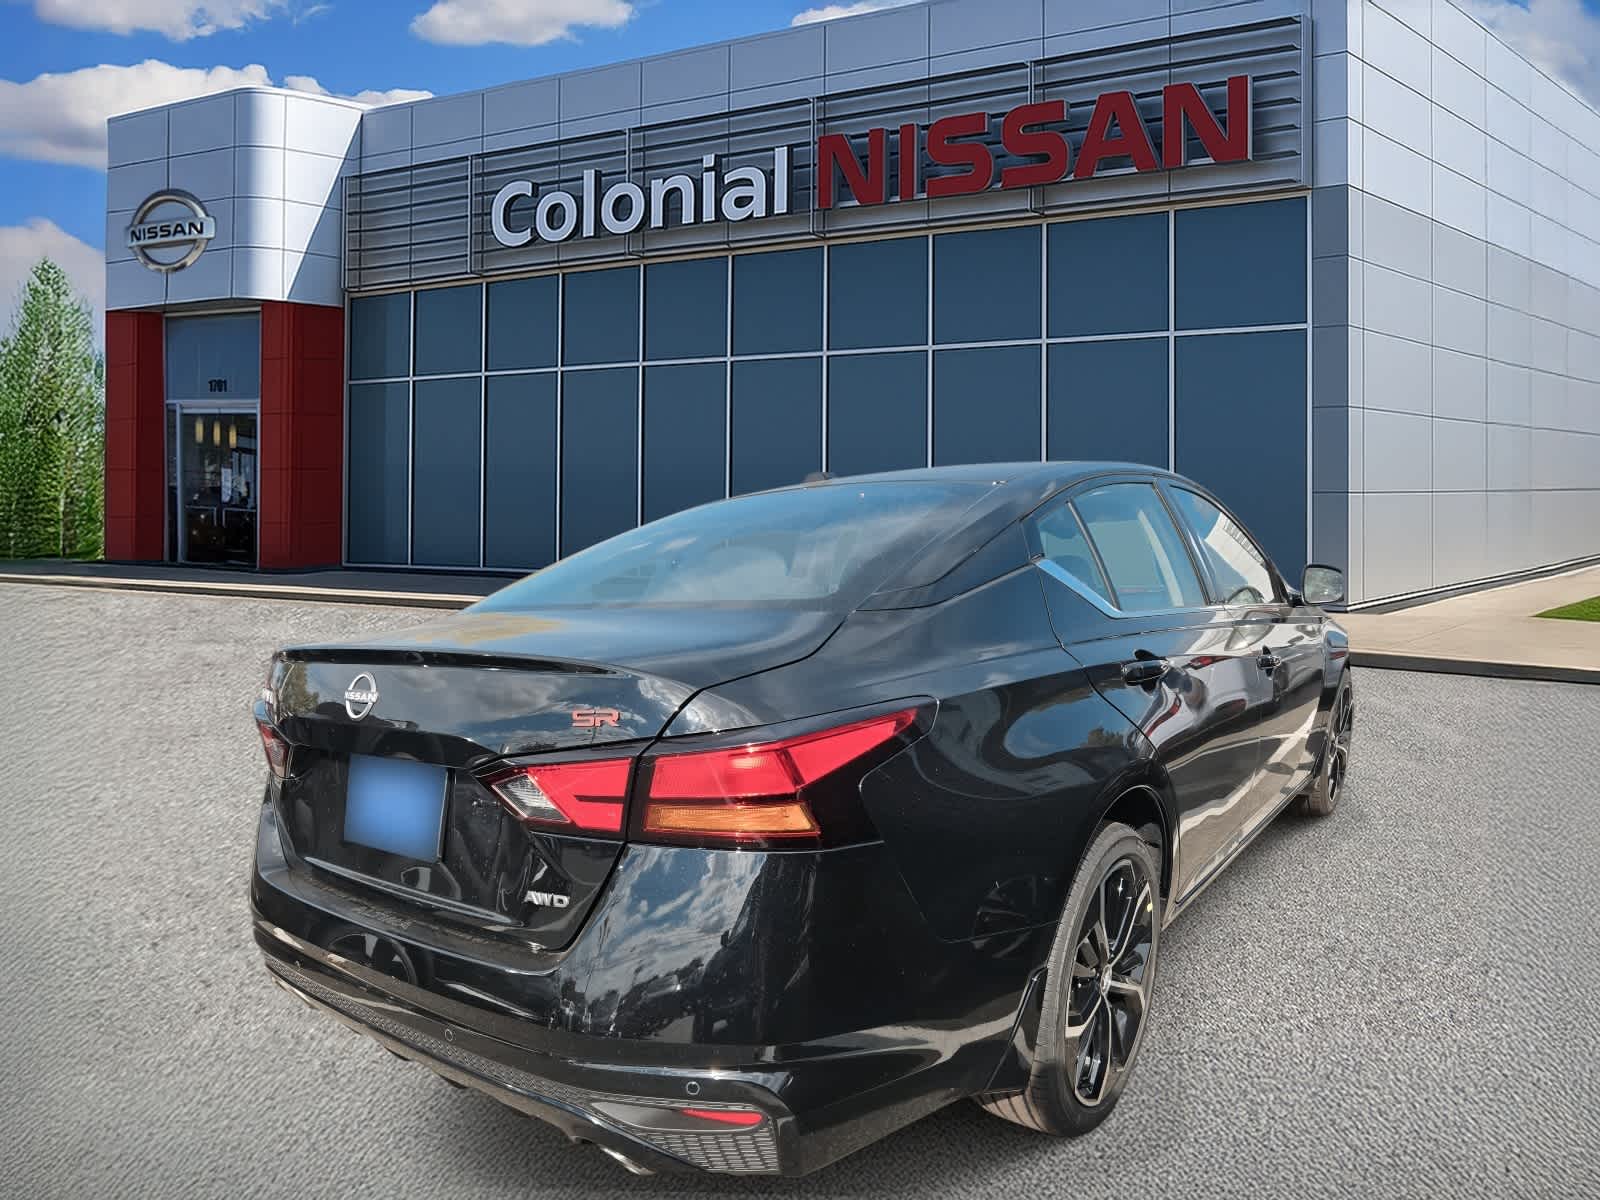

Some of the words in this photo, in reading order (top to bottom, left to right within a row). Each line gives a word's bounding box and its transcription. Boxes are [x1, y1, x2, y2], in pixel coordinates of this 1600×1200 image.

[490, 145, 791, 249] Colonial
[817, 74, 1253, 209] NISSAN
[130, 222, 204, 242] NISSAN
[345, 691, 378, 702] NISSAN
[572, 707, 620, 727] SR
[524, 890, 570, 908] AWD
